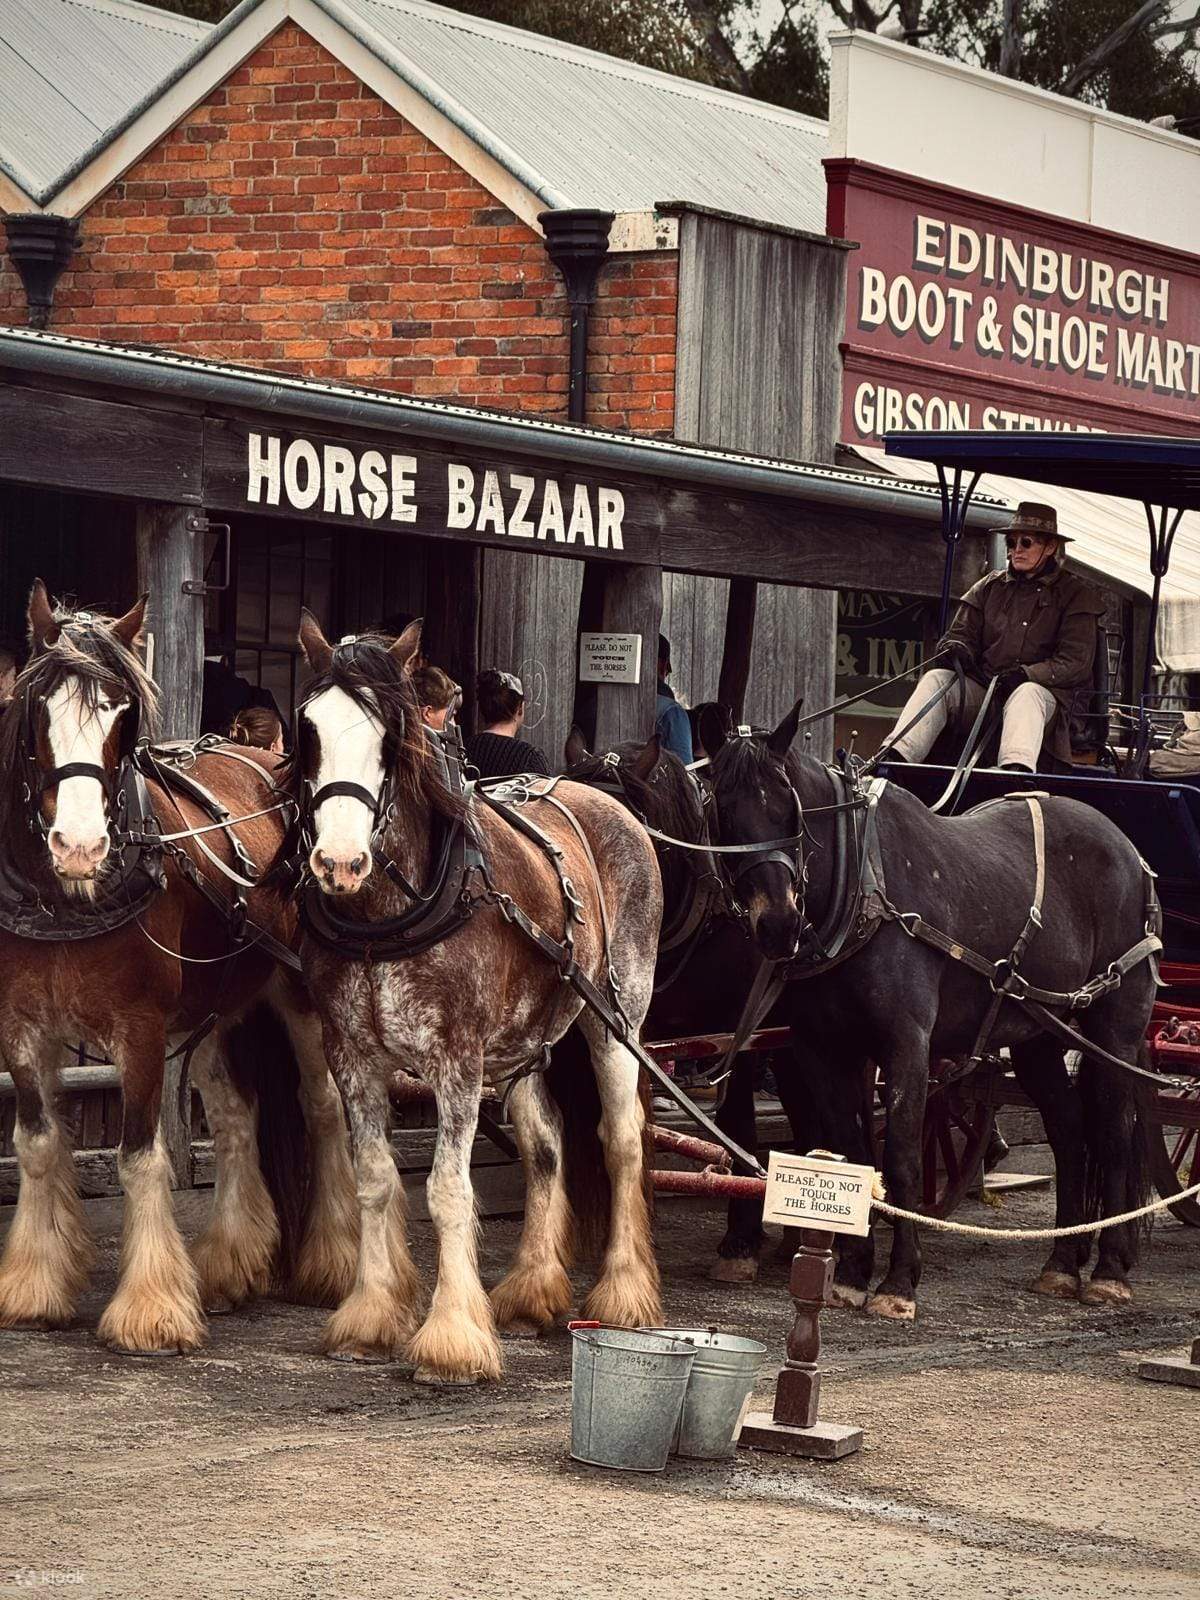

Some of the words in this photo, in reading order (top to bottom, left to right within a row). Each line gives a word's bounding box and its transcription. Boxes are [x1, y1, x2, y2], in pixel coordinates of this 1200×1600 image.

[914, 214, 1170, 323] EDINBURGH
[859, 266, 973, 344] BOOT
[976, 296, 1005, 353] &
[1011, 304, 1109, 375] SHOE
[1116, 327, 1200, 396] MART
[853, 382, 971, 435] GIBSON
[246, 432, 418, 523] HORSE
[446, 463, 625, 550] BAZAAR
[584, 643, 607, 652] PLEASE
[608, 644, 618, 652] DO
[619, 644, 633, 652] NOT
[590, 663, 602, 671] THE
[604, 663, 627, 672] HORSES
[775, 1172, 816, 1186] PLEASE
[819, 1178, 835, 1190] DO
[838, 1181, 863, 1194] NOT
[800, 1187, 836, 1201] TOUCH
[784, 1196, 806, 1209] THE
[811, 1200, 851, 1215] HORSES
